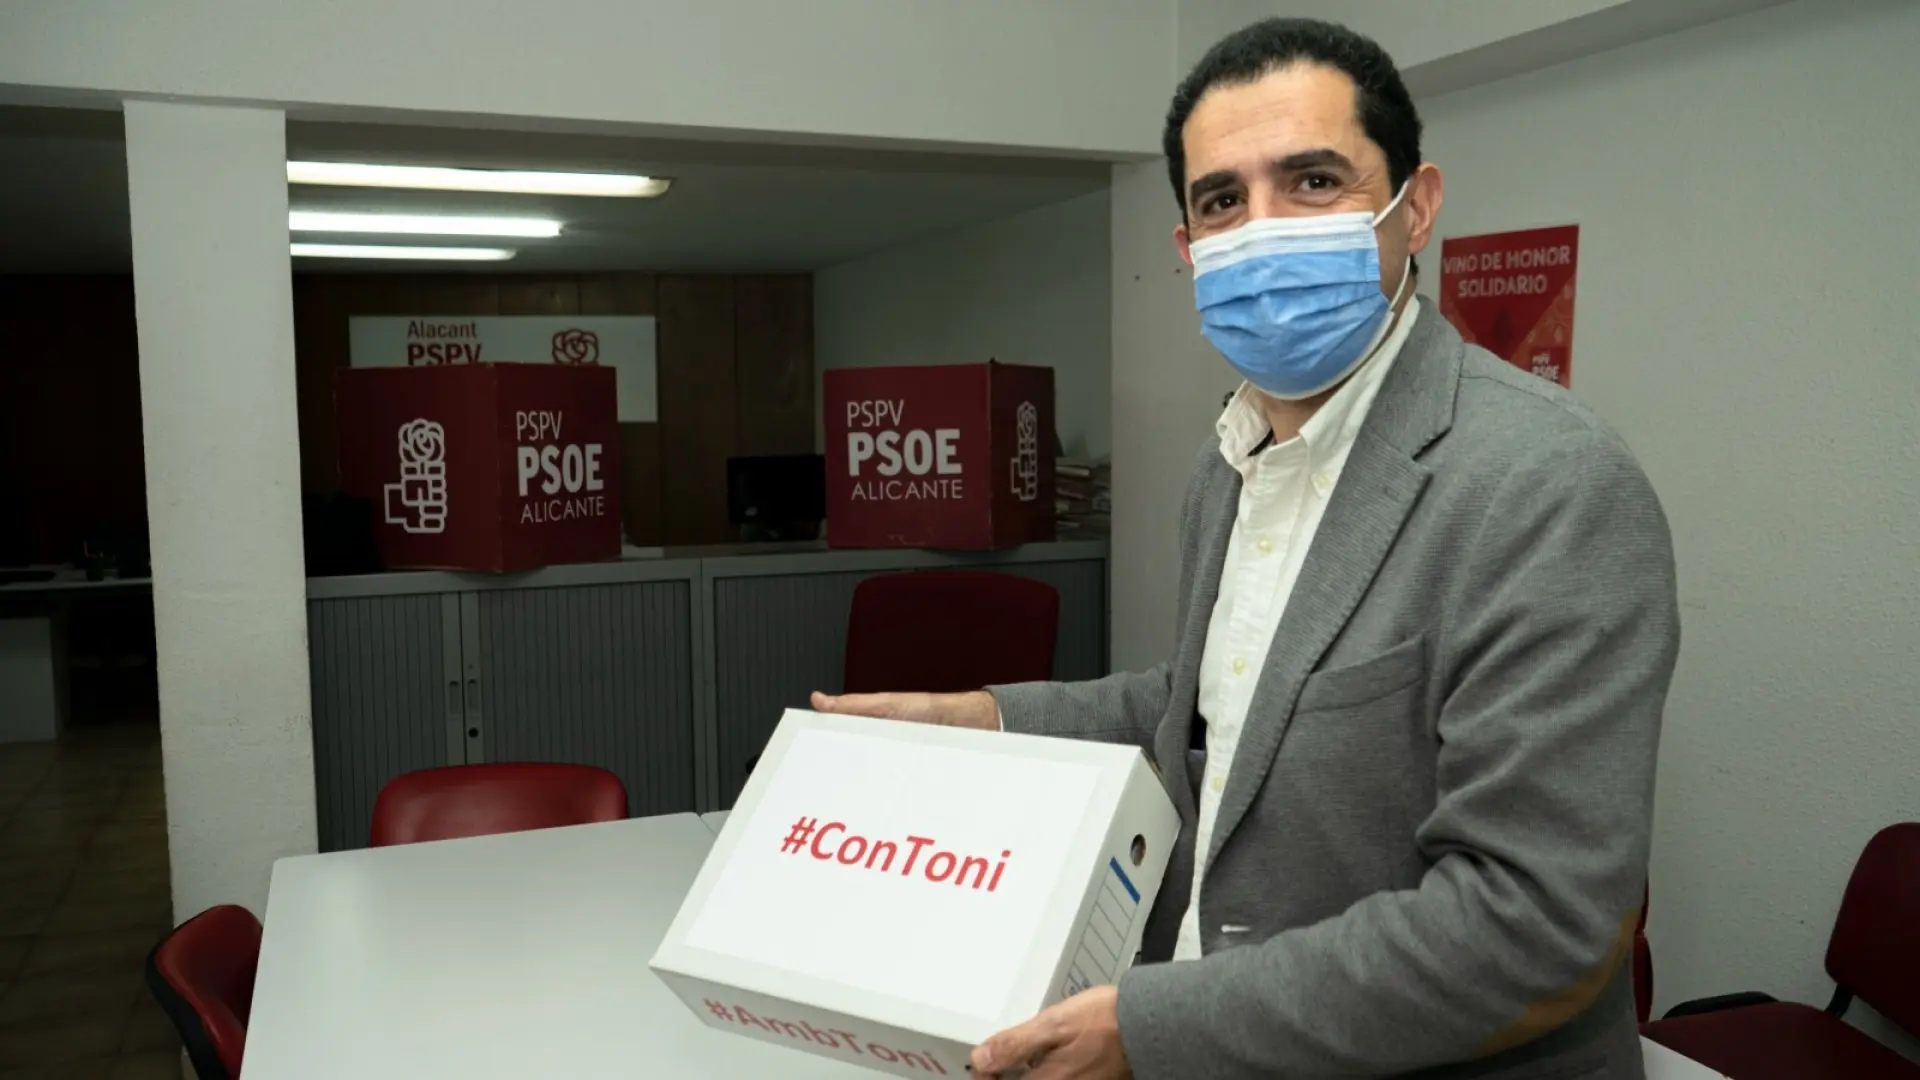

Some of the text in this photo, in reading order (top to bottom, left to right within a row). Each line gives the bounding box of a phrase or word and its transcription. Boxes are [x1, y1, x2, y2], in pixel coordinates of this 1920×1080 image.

[1444, 245, 1570, 273] VINO DE HONOR
[1458, 274, 1548, 297] SOLIDARIO
[408, 320, 477, 338] Alacant
[407, 343, 482, 366] PSPV
[516, 411, 562, 441] PSPV
[846, 399, 904, 427] PSPV
[847, 428, 963, 477] PSOE
[517, 443, 604, 496] PSOE
[851, 479, 963, 501] ALICANTE
[520, 496, 605, 524] ALICANTE
[780, 816, 1012, 893] #ConToni
[703, 998, 948, 1076] #AmbToni
